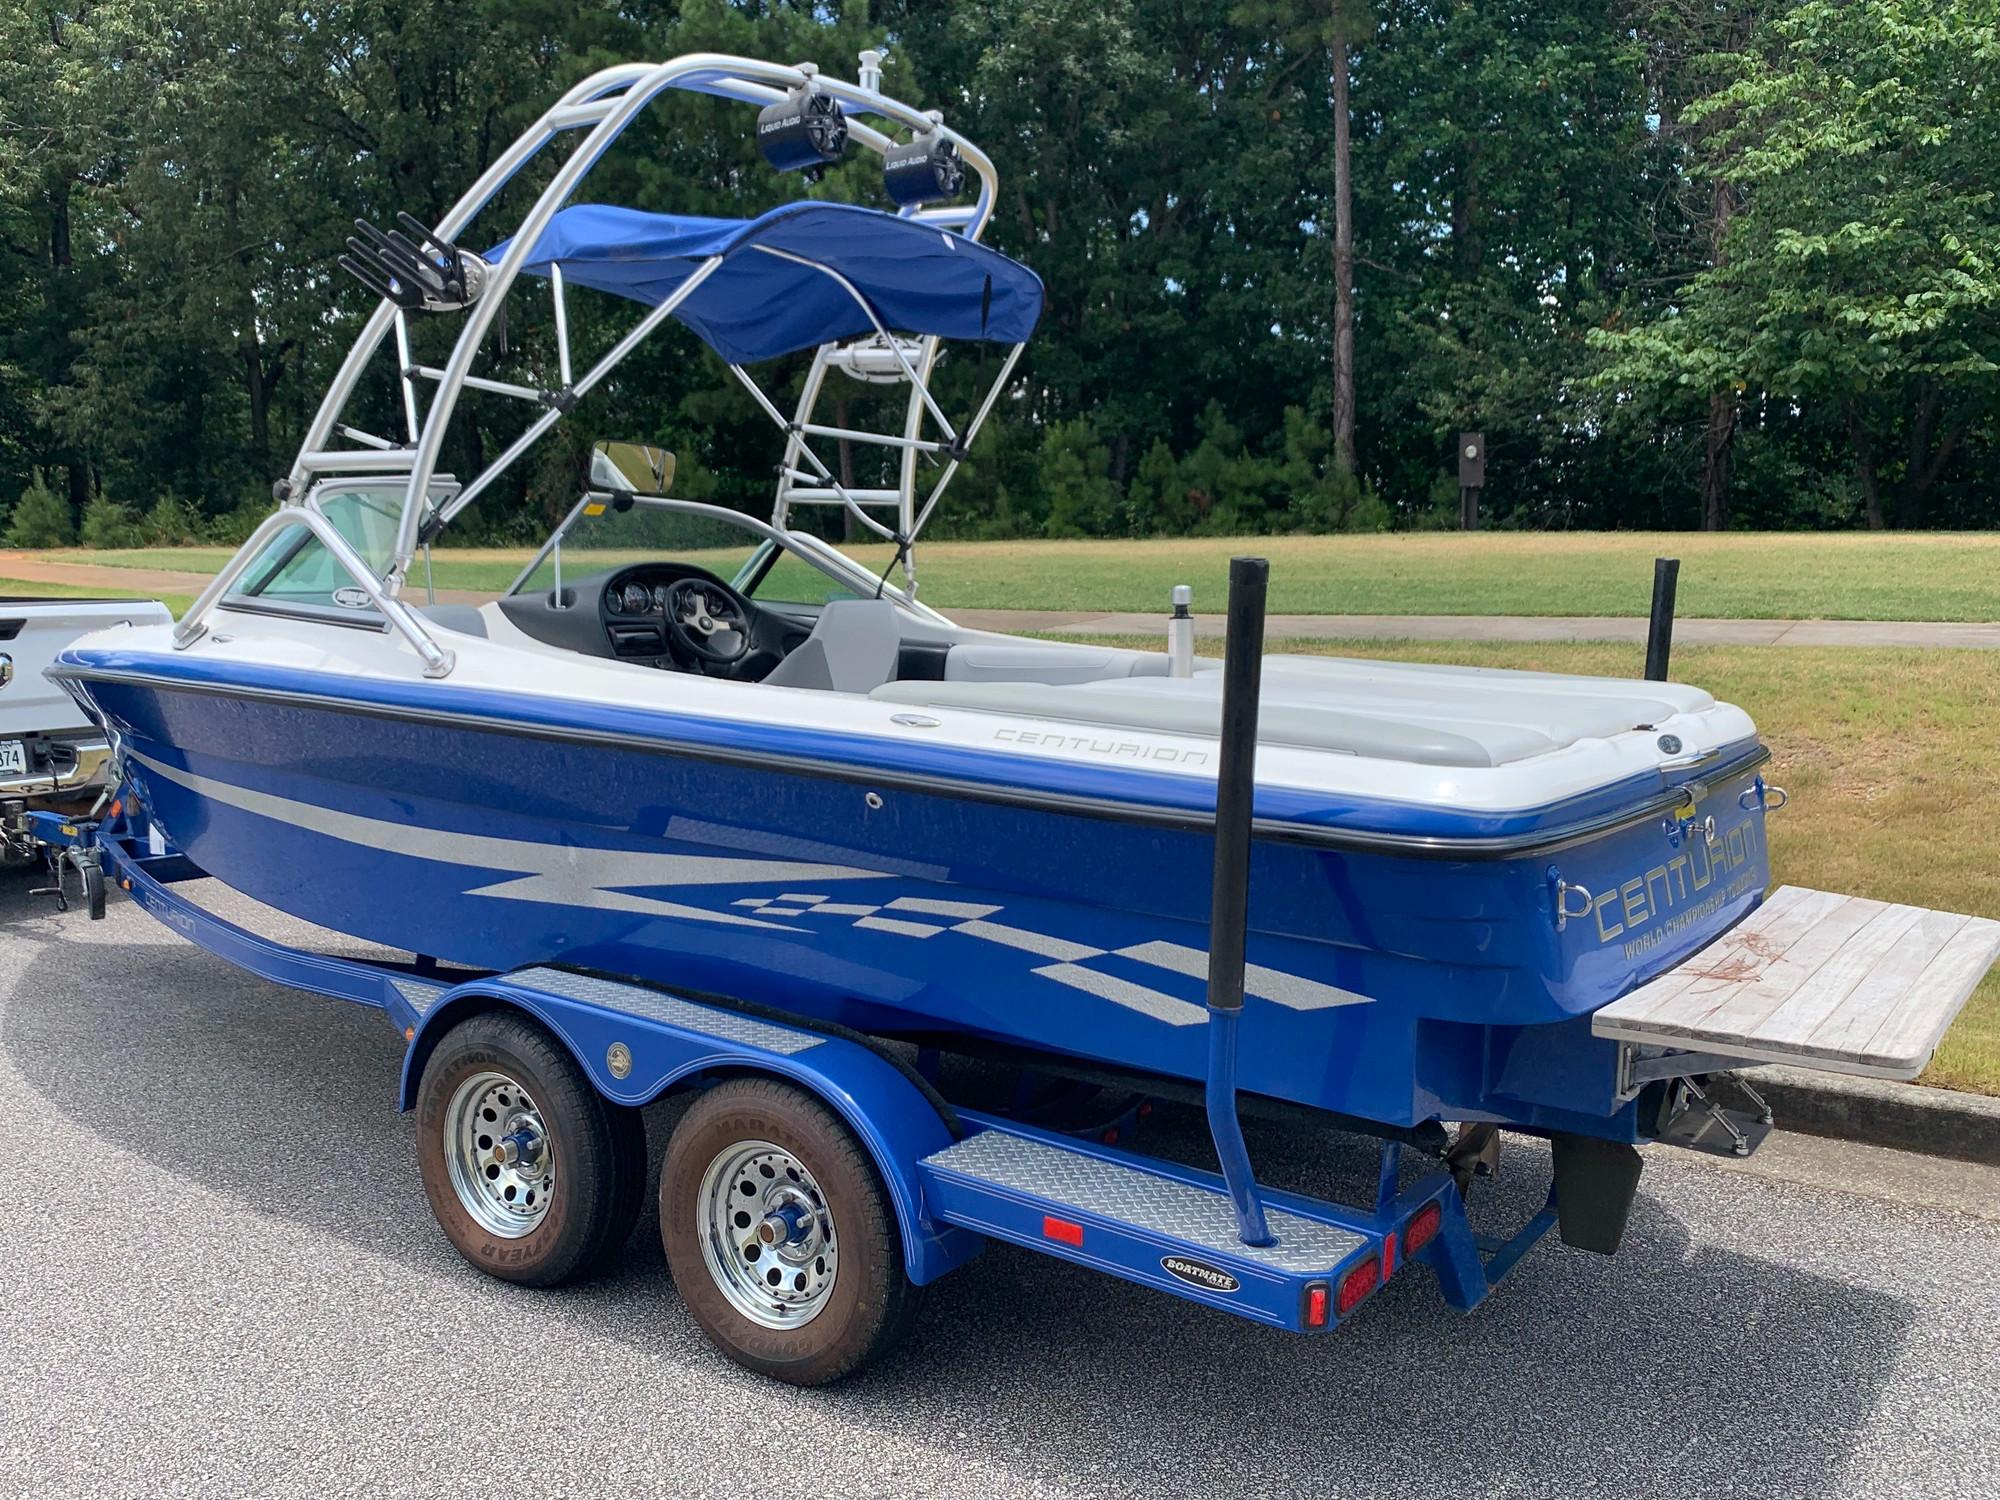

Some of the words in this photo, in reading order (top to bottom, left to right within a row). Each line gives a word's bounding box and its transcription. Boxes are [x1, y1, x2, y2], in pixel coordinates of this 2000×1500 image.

[781, 115, 801, 128] AUDIO
[993, 728, 1208, 766] CENTURION
[1594, 820, 1758, 943] CENTURION
[144, 891, 197, 935] CENTURION
[1624, 923, 1664, 961] WORLD
[1166, 1259, 1233, 1287] BOATMATE
